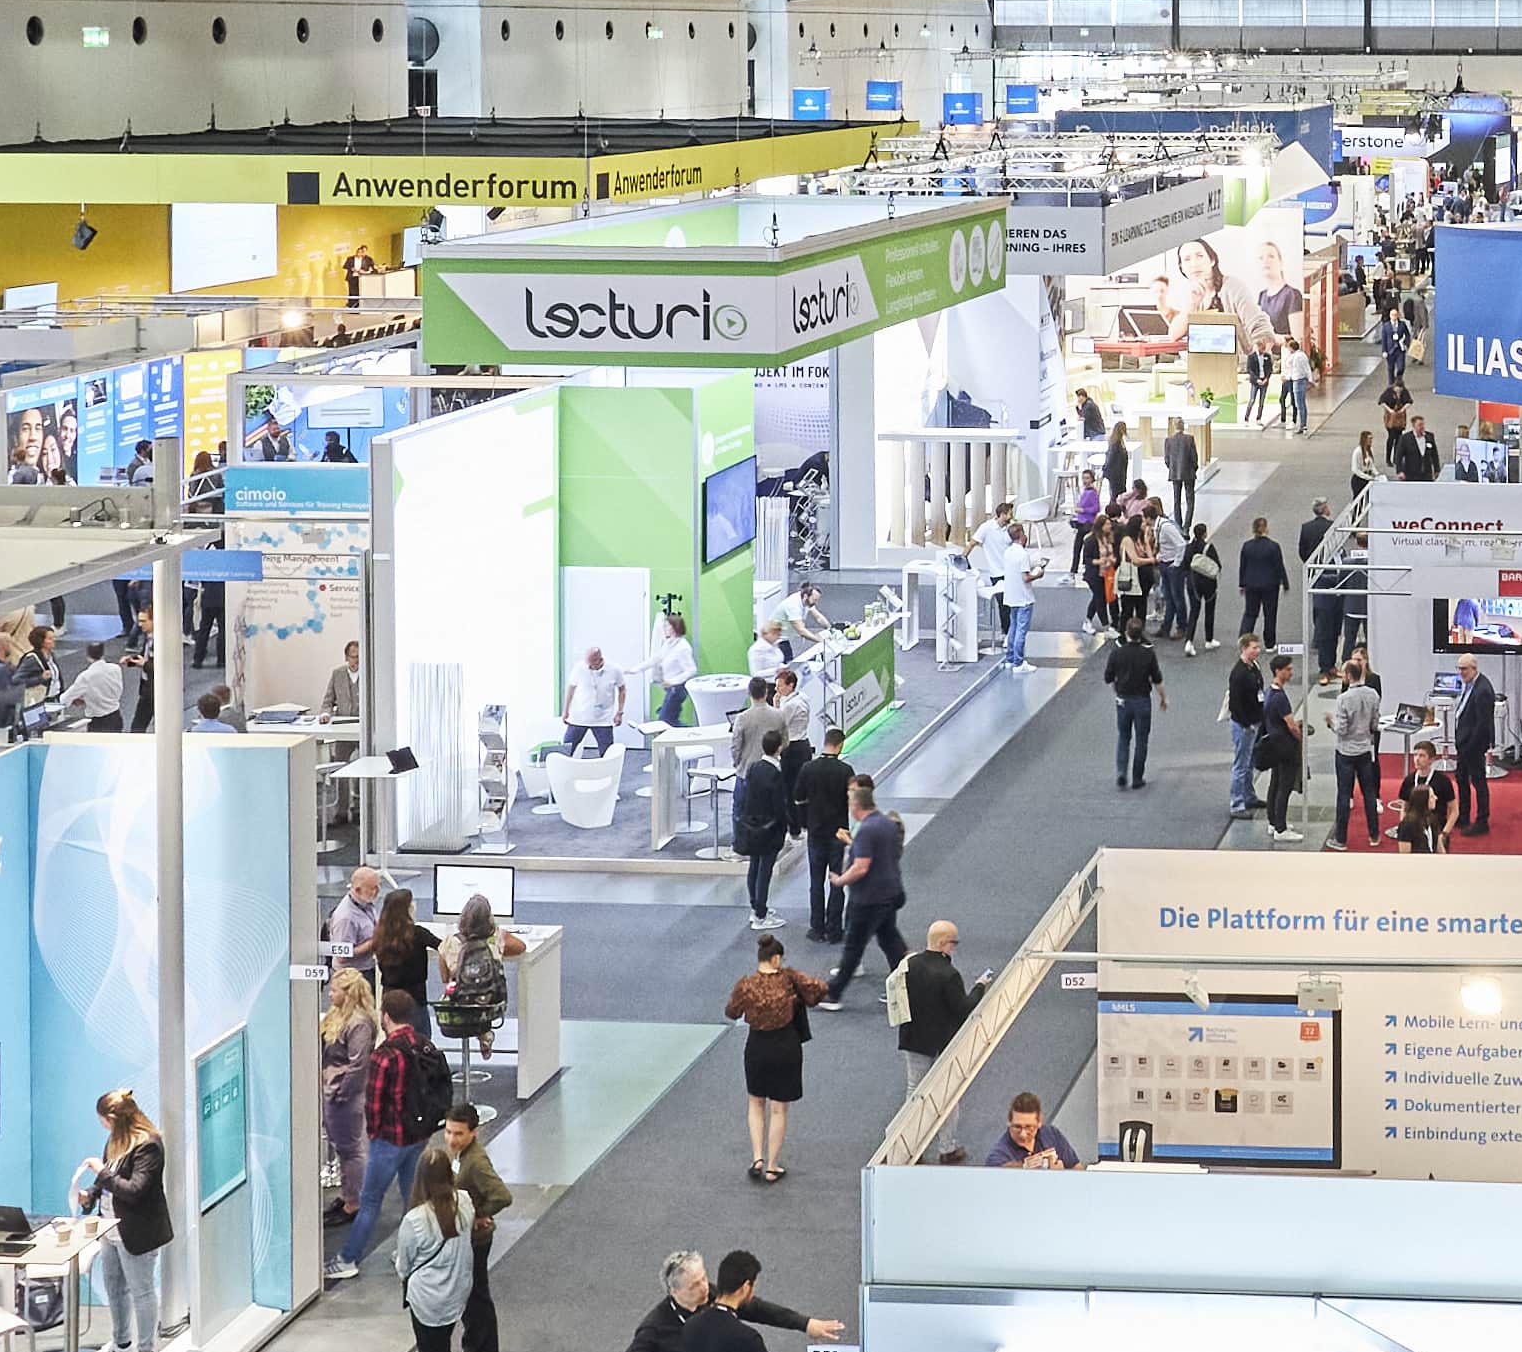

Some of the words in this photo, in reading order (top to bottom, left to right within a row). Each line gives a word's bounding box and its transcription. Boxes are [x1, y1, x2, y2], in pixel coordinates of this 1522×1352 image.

[1343, 135, 1404, 149] erstone
[332, 171, 577, 200] Anwenderforum
[614, 164, 703, 197] Anwenderforum
[1044, 229, 1067, 240] DAS
[1052, 244, 1086, 254] IHRES
[793, 367, 804, 378] IM
[1392, 537, 1424, 547] Virtual
[1159, 907, 1201, 931] Die
[1207, 908, 1326, 933] Plattform
[1333, 909, 1370, 934] für
[1376, 912, 1430, 935] eine
[331, 945, 350, 955] E50
[305, 968, 325, 978] D59
[1064, 976, 1085, 988] D52
[1404, 1015, 1453, 1031] Mobile
[1459, 1015, 1496, 1031] Lern-
[1404, 1043, 1451, 1061] Eigene
[1457, 1043, 1522, 1061] Aufgaben
[1404, 1071, 1489, 1087] Individuelle
[1404, 1098, 1520, 1115] Dokumentierter
[1404, 1126, 1485, 1144] Einbindung
